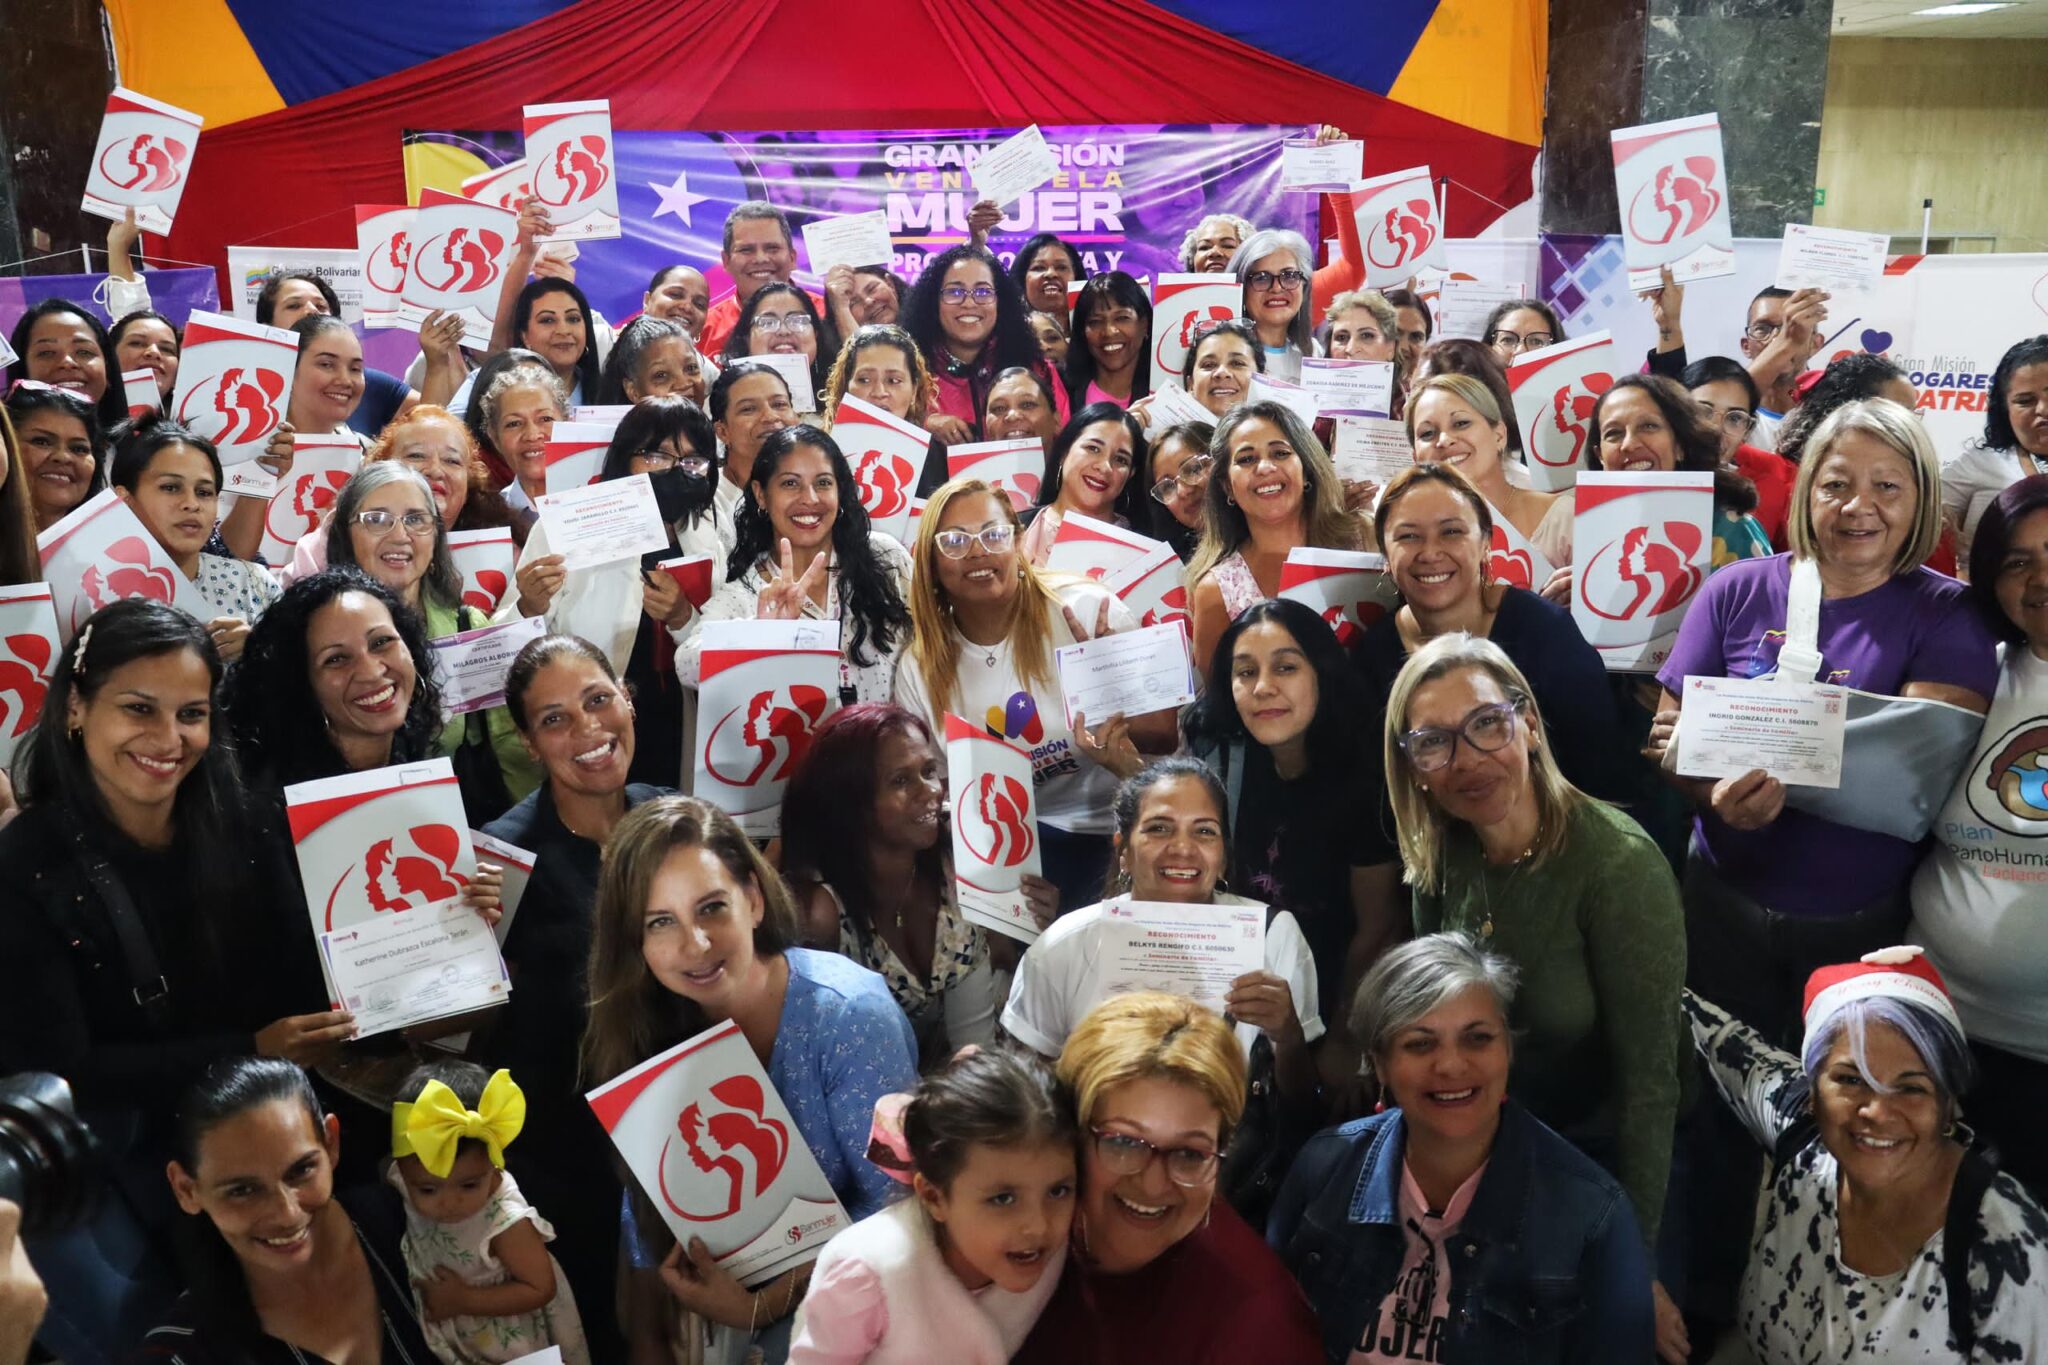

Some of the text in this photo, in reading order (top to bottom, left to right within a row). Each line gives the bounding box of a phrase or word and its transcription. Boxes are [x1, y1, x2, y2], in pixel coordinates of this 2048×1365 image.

[884, 144, 984, 168] GRAN
[1047, 138, 1124, 167] SIÓN
[885, 171, 1123, 189] VENELA
[1104, 251, 1124, 271] Y
[1894, 354, 1975, 373] Gran Misión
[1909, 372, 1998, 389] OGARES
[1914, 389, 1988, 412] ATRI
[453, 649, 521, 669] MILAGROS ALBORNO
[1708, 712, 1734, 721] INGRID
[1735, 714, 1773, 723] GONZALEZ
[1729, 704, 1799, 715] RECONOCIMIENTO
[1030, 738, 1069, 760] ISIÓN
[1945, 822, 1994, 841] Plan
[1147, 930, 1217, 941] RECONOCIMIENTO
[1128, 941, 1157, 949] BELKYS
[1158, 942, 1190, 951] RENGIFO
[354, 951, 388, 968] Katherine
[1354, 1308, 1448, 1364] UJER
